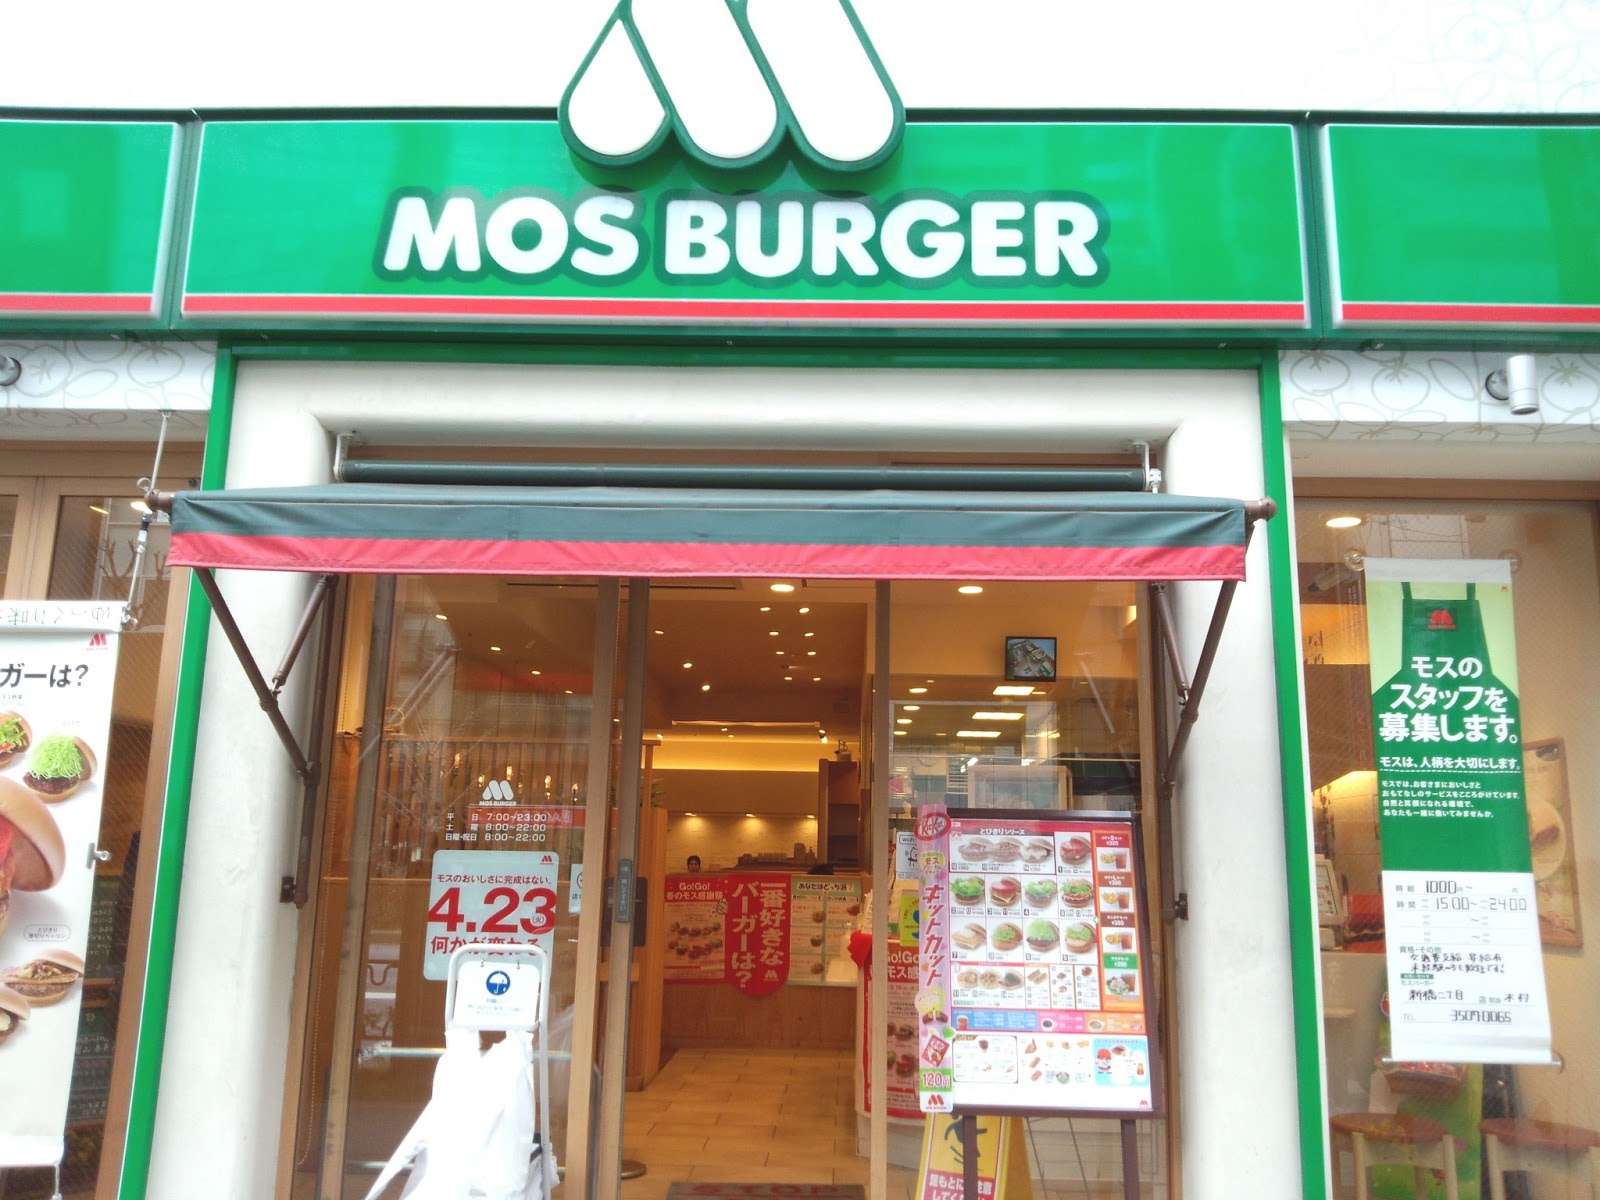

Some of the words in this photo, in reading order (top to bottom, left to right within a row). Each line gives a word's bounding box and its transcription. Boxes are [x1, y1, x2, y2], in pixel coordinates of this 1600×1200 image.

[383, 196, 640, 276] MOS
[664, 200, 1099, 279] BURGER
[1410, 656, 1483, 679] モスの
[1389, 683, 1509, 714] スタッフを
[1378, 712, 1519, 744] 募集します。
[1379, 756, 1521, 770] モスは、人柄を大切にします。
[436, 873, 552, 885] モスのおいしさに完成はない。
[678, 881, 711, 891] Go!Go!
[427, 886, 557, 935] 4.23
[531, 915, 546, 924] (火)
[759, 882, 787, 967] 一番好きな
[731, 880, 760, 989] バーガーは?
[922, 883, 946, 987] キットカット
